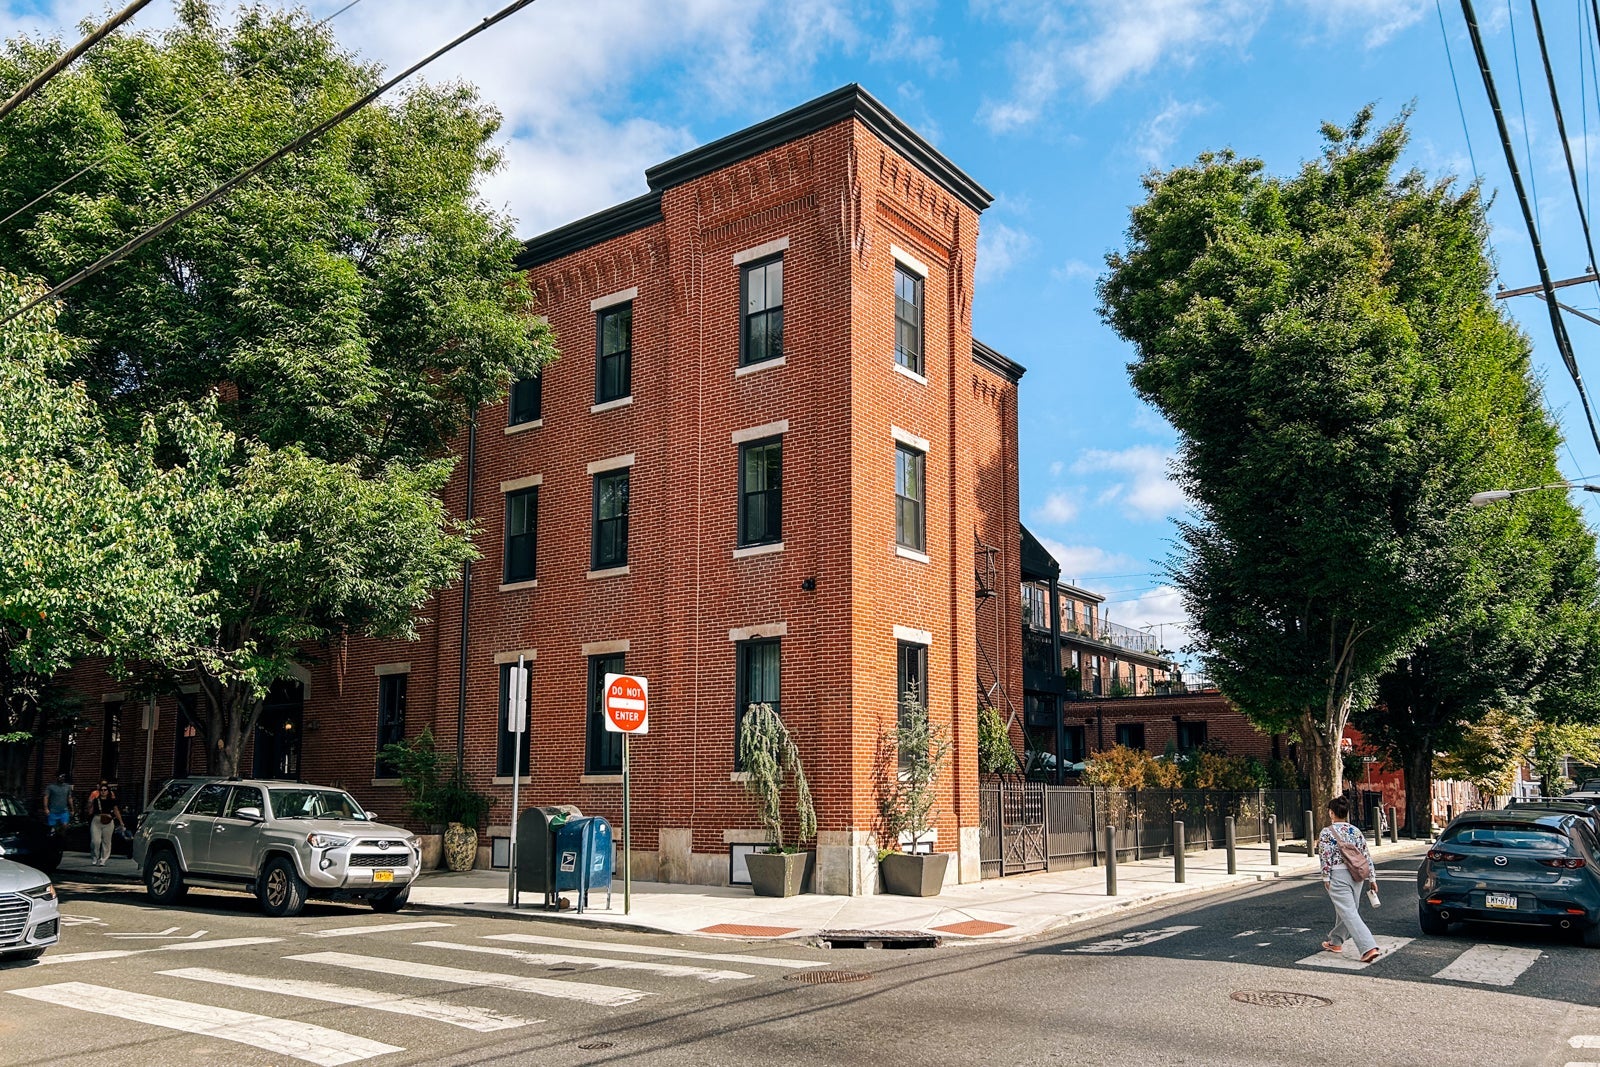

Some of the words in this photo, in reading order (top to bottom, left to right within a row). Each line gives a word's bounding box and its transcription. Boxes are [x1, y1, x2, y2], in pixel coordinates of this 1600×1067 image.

[612, 686, 622, 695] DO
[626, 687, 641, 697] NOT
[615, 711, 639, 721] ENTER
